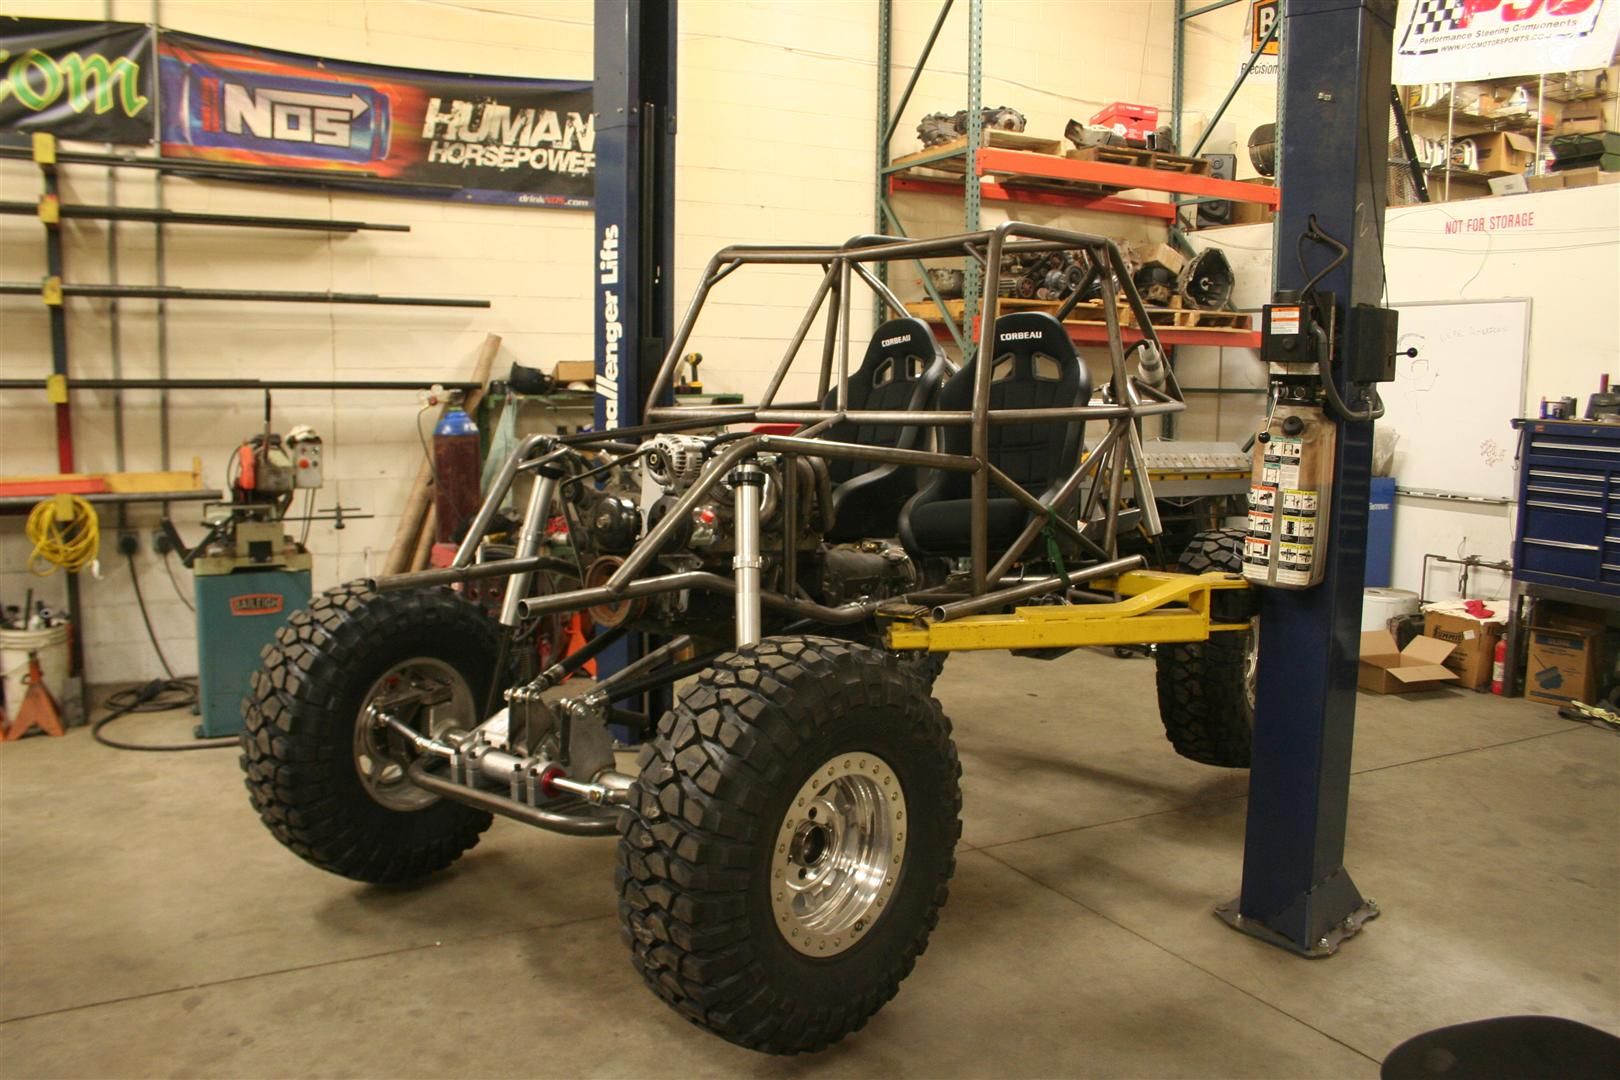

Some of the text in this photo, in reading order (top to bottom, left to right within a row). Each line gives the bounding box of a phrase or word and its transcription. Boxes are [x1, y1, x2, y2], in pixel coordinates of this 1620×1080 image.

[1418, 32, 1473, 45] Performance
[1475, 27, 1510, 38] Steering
[1241, 62, 1279, 74] Pecision
[224, 83, 352, 148] NOS
[422, 97, 596, 152] HUMAN
[1445, 211, 1534, 234] NOT FOR STORAGE
[596, 224, 623, 431] allenger Lifts
[1000, 331, 1043, 341] CORBEAU
[881, 334, 912, 348] CORBEAU
